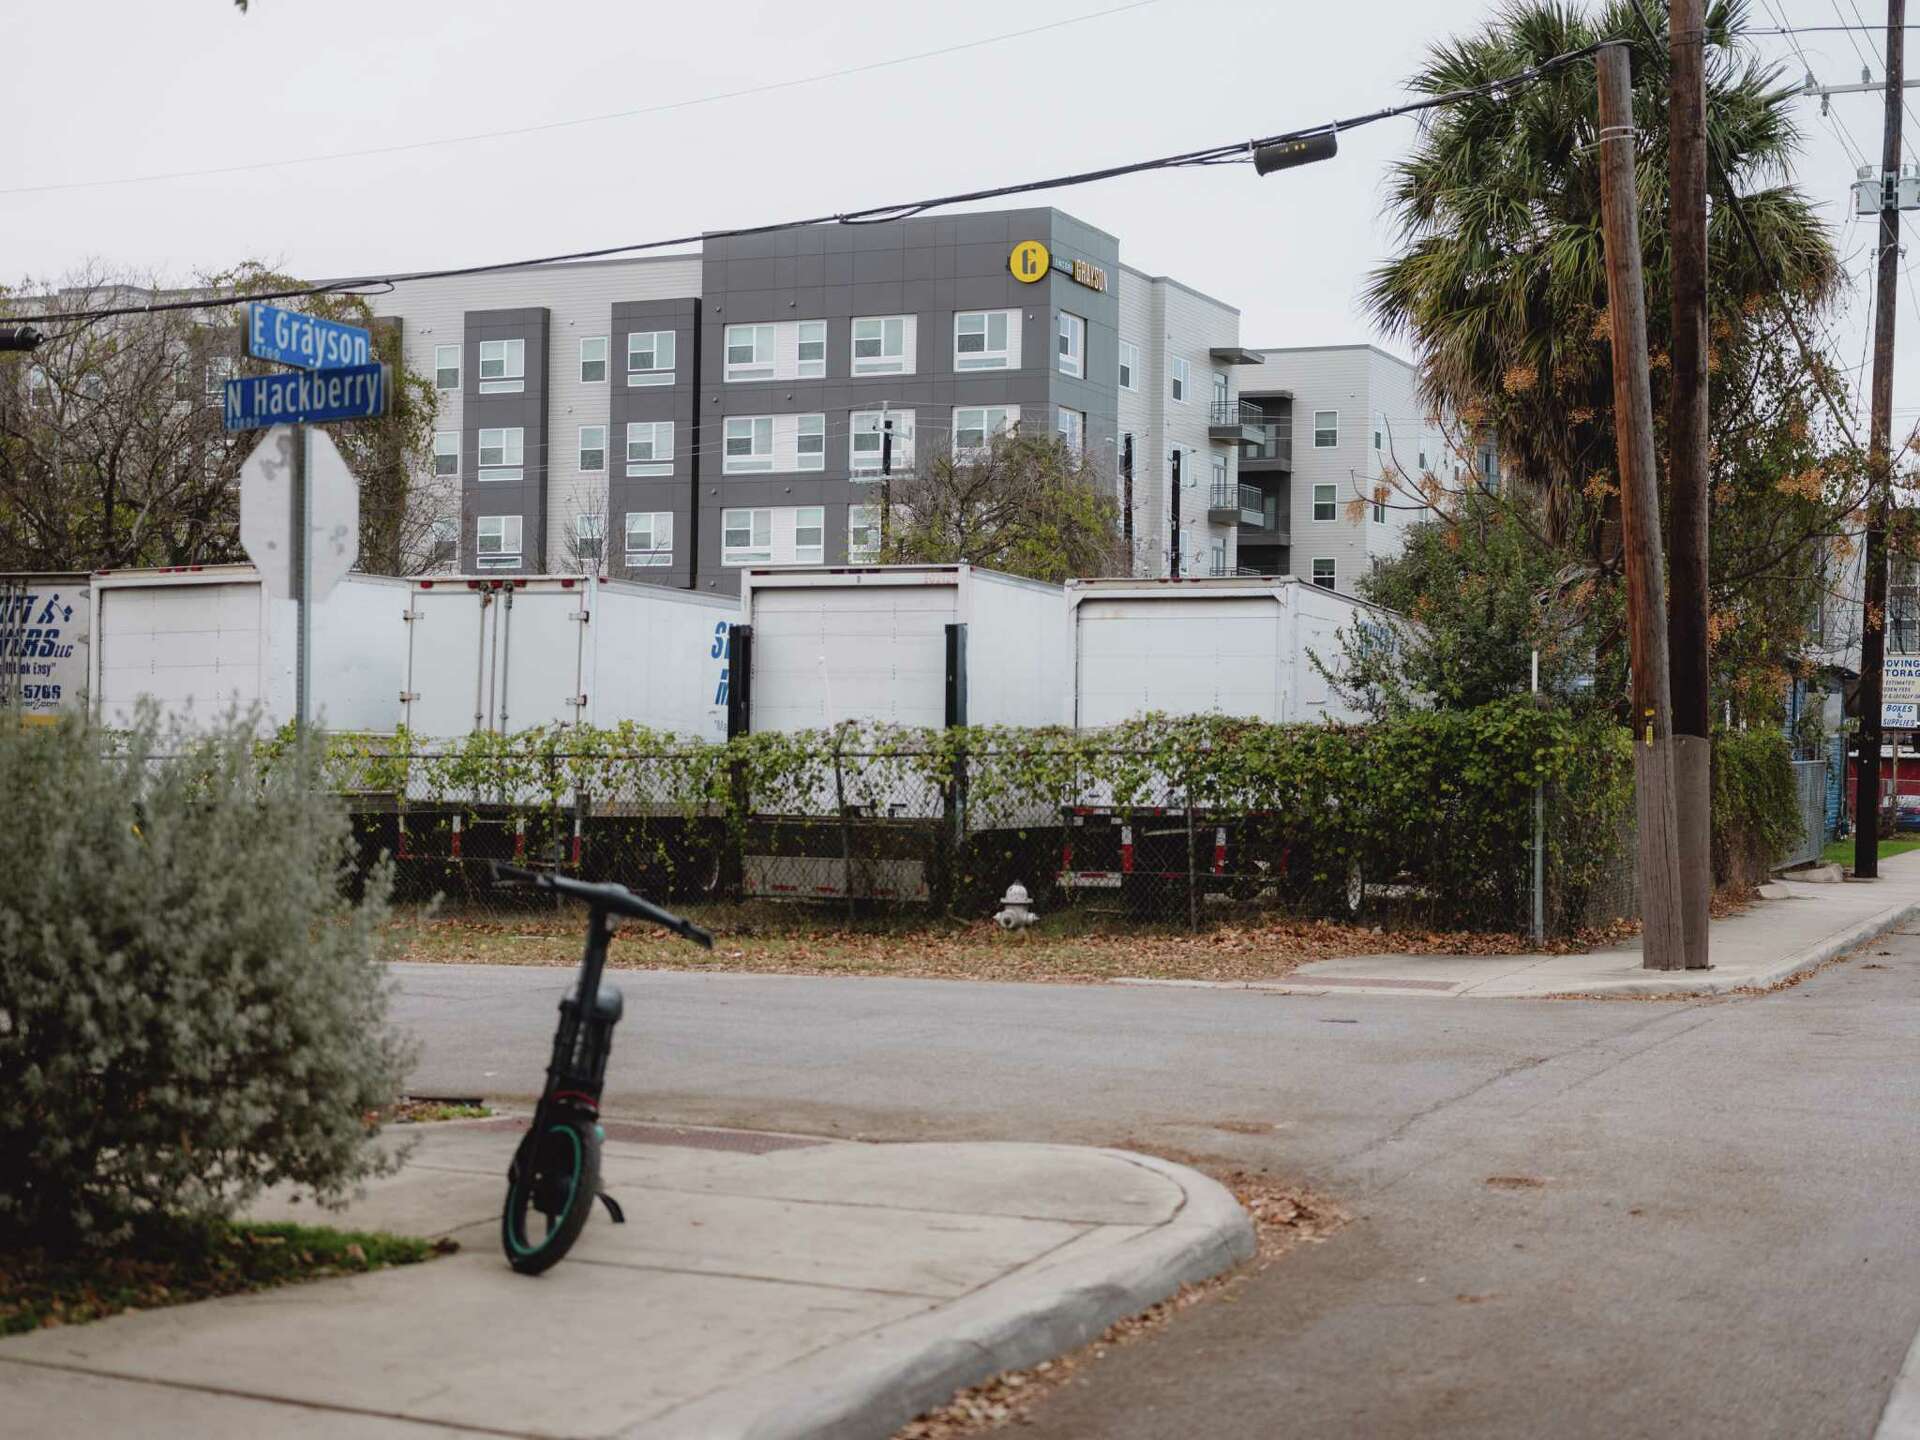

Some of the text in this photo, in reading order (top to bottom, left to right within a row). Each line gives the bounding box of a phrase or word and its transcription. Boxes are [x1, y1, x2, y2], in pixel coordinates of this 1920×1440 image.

[1074, 259, 1108, 293] GRAYSON
[253, 306, 367, 367] E Grayson
[227, 370, 379, 418] N Hackberry
[53, 644, 74, 658] LLC
[1886, 659, 1920, 668] OVING
[1886, 669, 1920, 677] TORAG
[1886, 704, 1913, 713] BOXES
[1883, 719, 1915, 727] SUPPLIES
